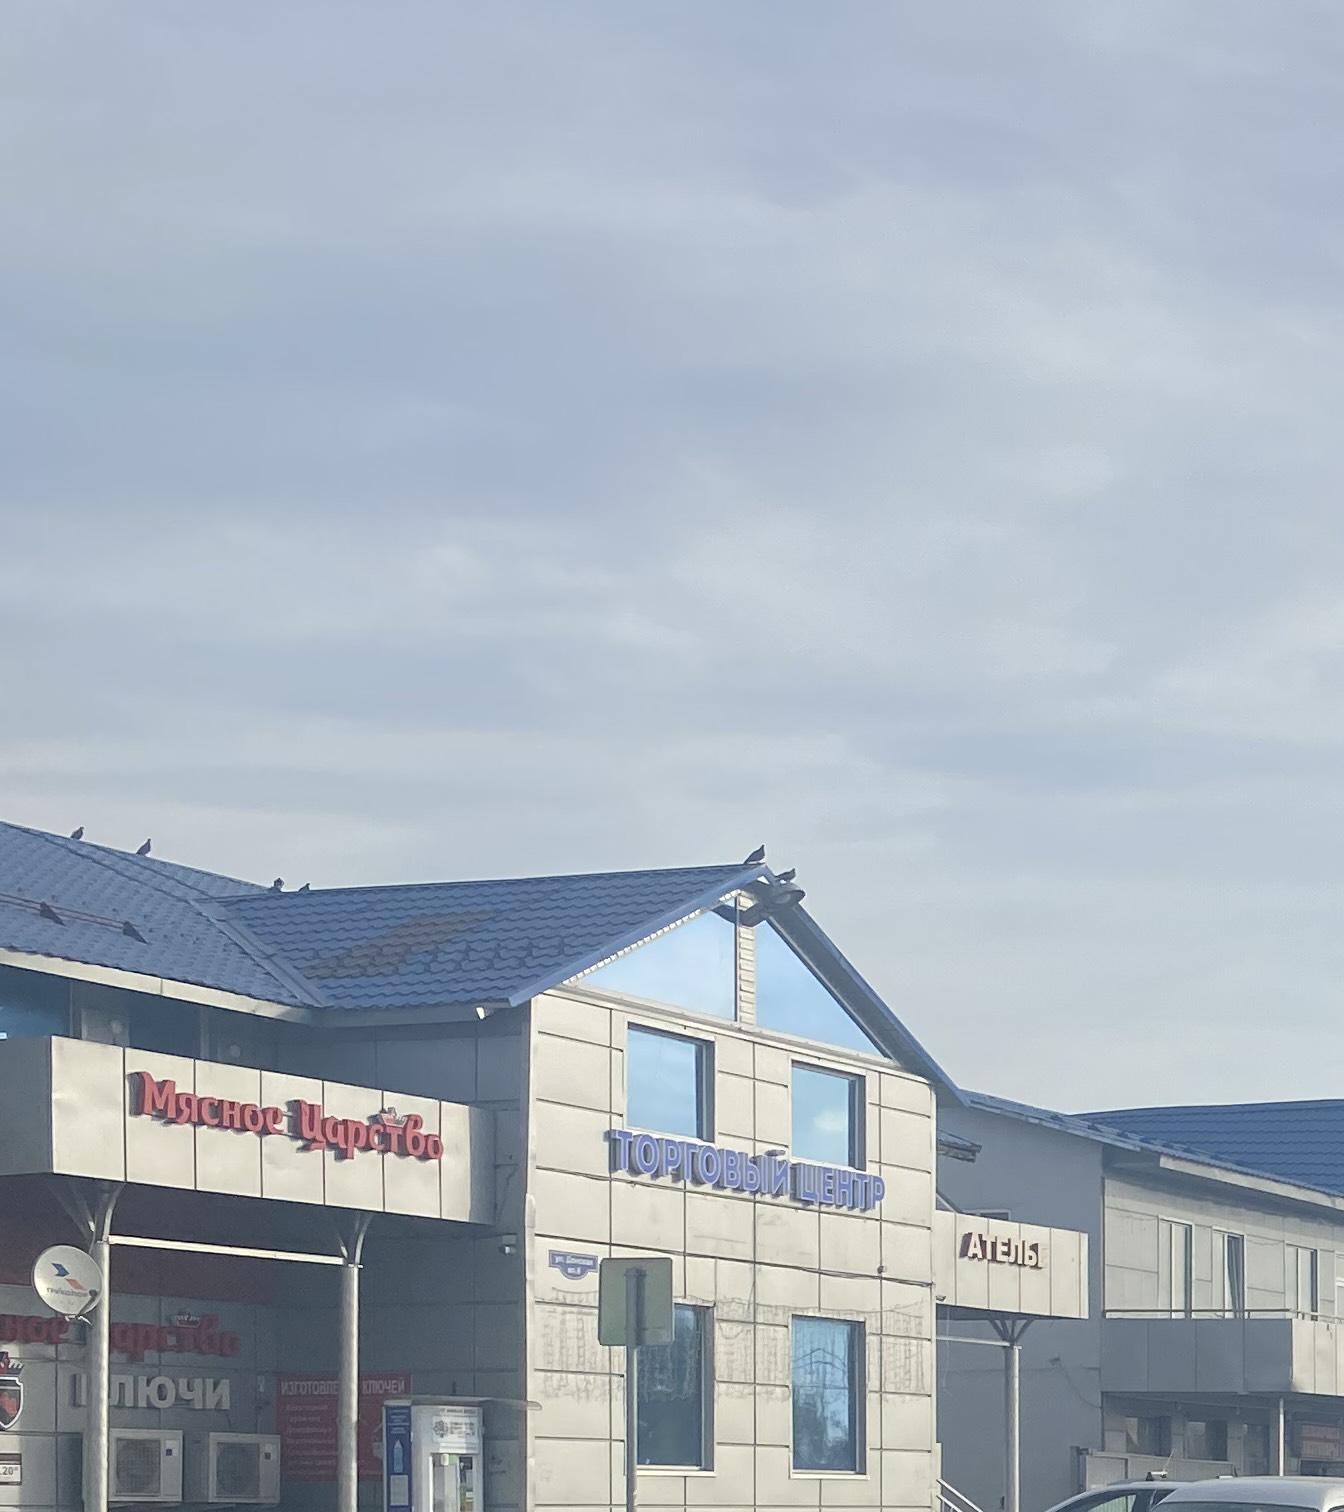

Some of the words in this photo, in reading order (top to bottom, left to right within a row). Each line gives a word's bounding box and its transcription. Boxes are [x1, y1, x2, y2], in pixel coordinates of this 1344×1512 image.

[136, 1071, 284, 1135] Мясное
[296, 1099, 444, 1160] Царство
[613, 1129, 791, 1197] ТОРГОВЫЙ
[798, 1162, 886, 1210] ЦЕНТР
[281, 1380, 340, 1396] ИЗГОТОВЛЕ
[362, 1377, 405, 1395] КЛЮЧЕЙ
